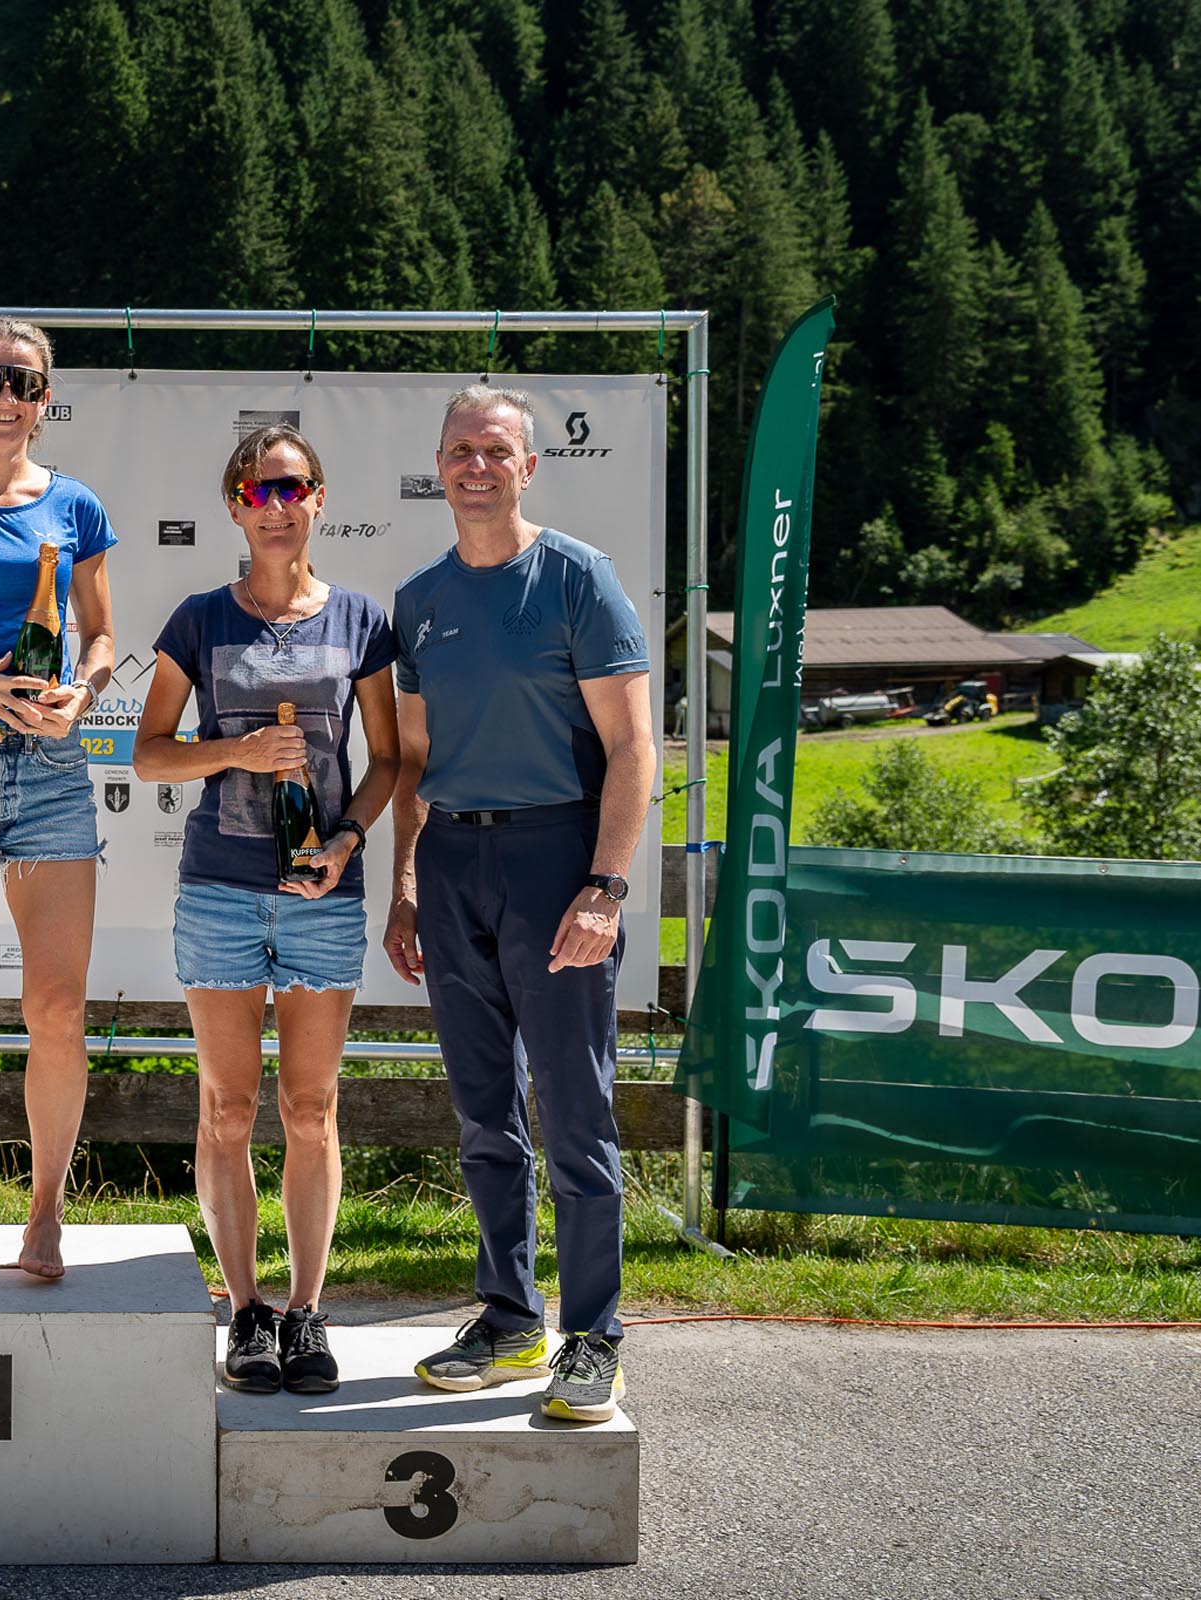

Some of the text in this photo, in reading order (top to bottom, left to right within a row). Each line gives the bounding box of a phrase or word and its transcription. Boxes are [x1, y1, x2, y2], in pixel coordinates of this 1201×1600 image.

[542, 448, 613, 458] SCOTT
[762, 488, 793, 689] Luxner
[441, 627, 459, 639] TEAM
[94, 698, 143, 714] ars
[803, 938, 1200, 1049] SKO
[383, 1450, 459, 1540] 3
